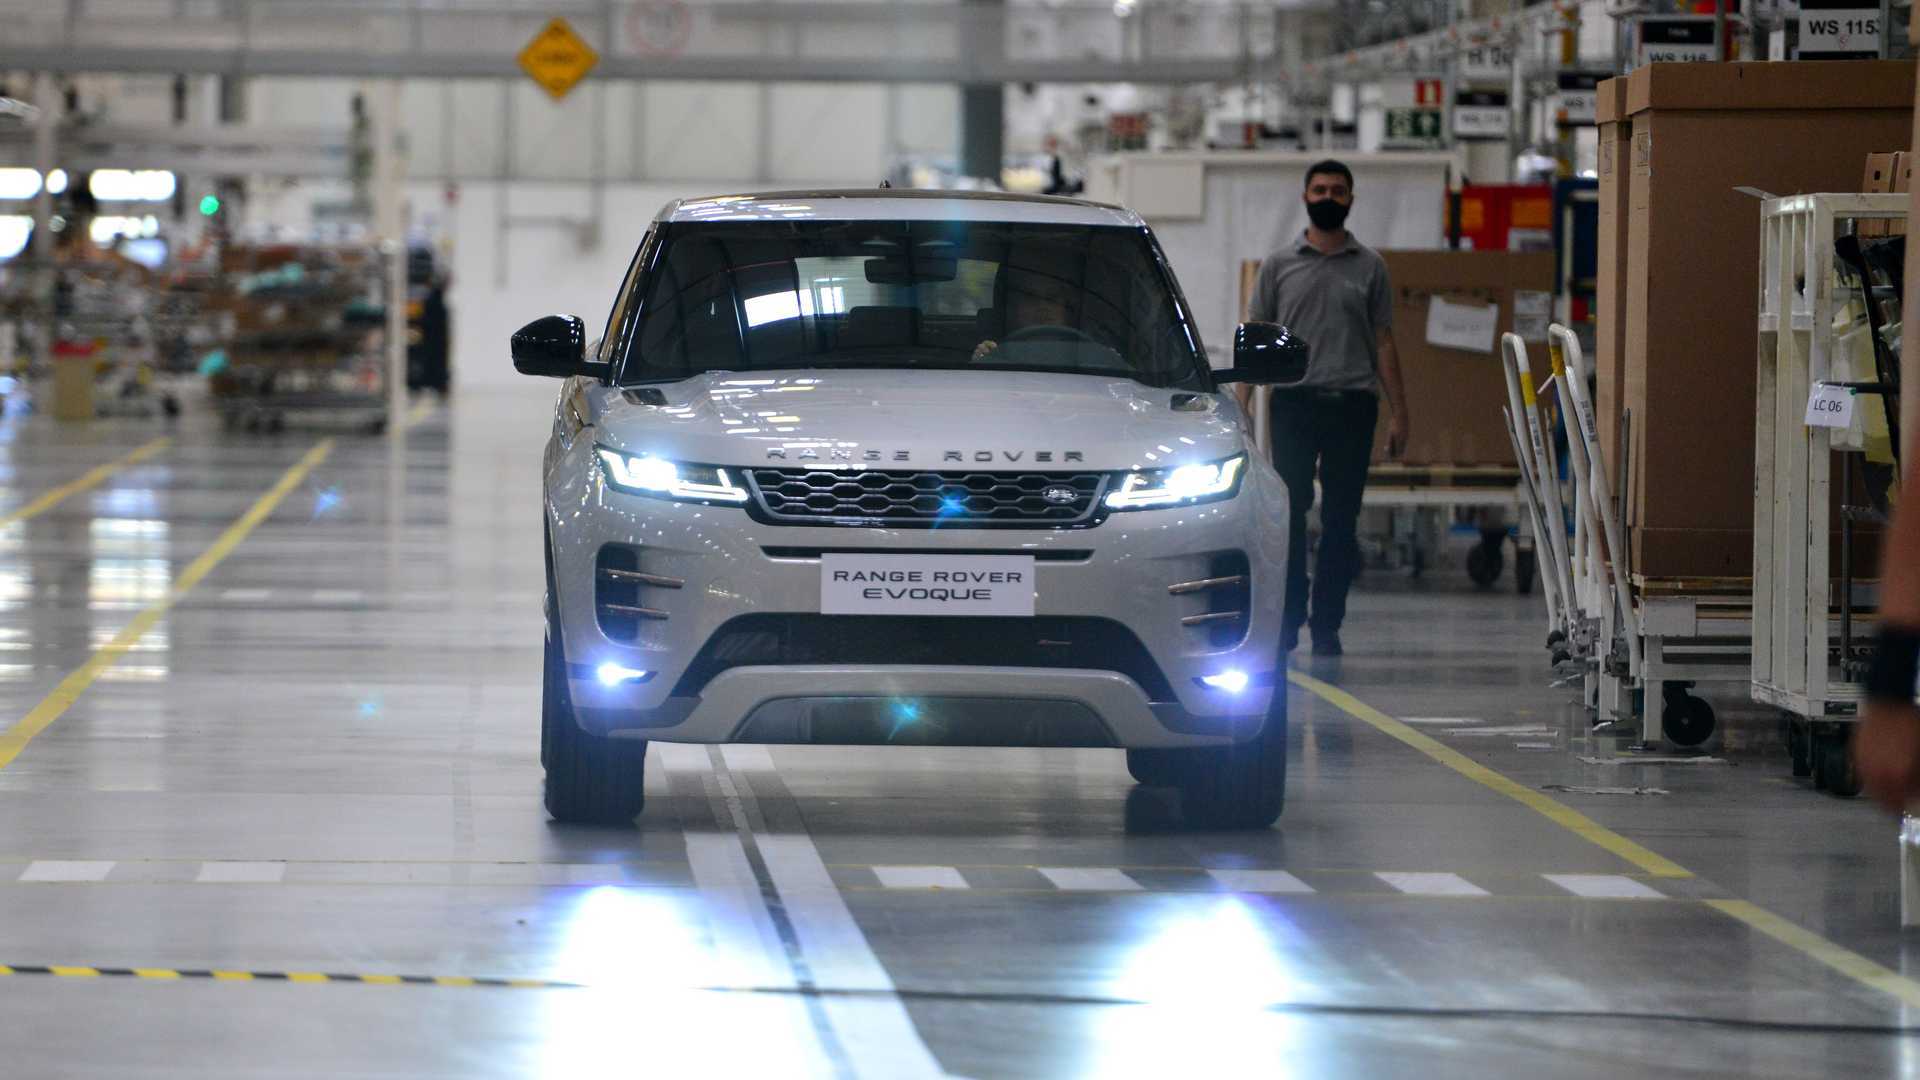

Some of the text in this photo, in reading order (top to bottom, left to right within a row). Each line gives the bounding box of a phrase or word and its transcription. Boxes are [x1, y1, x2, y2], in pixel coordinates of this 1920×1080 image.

[1808, 19, 1839, 35] WS
[1813, 399, 1842, 413] LC 06
[766, 447, 1084, 462] RANGE ROVER
[833, 570, 1023, 583] RANGE ROVER
[863, 588, 993, 602] EVOQUE
